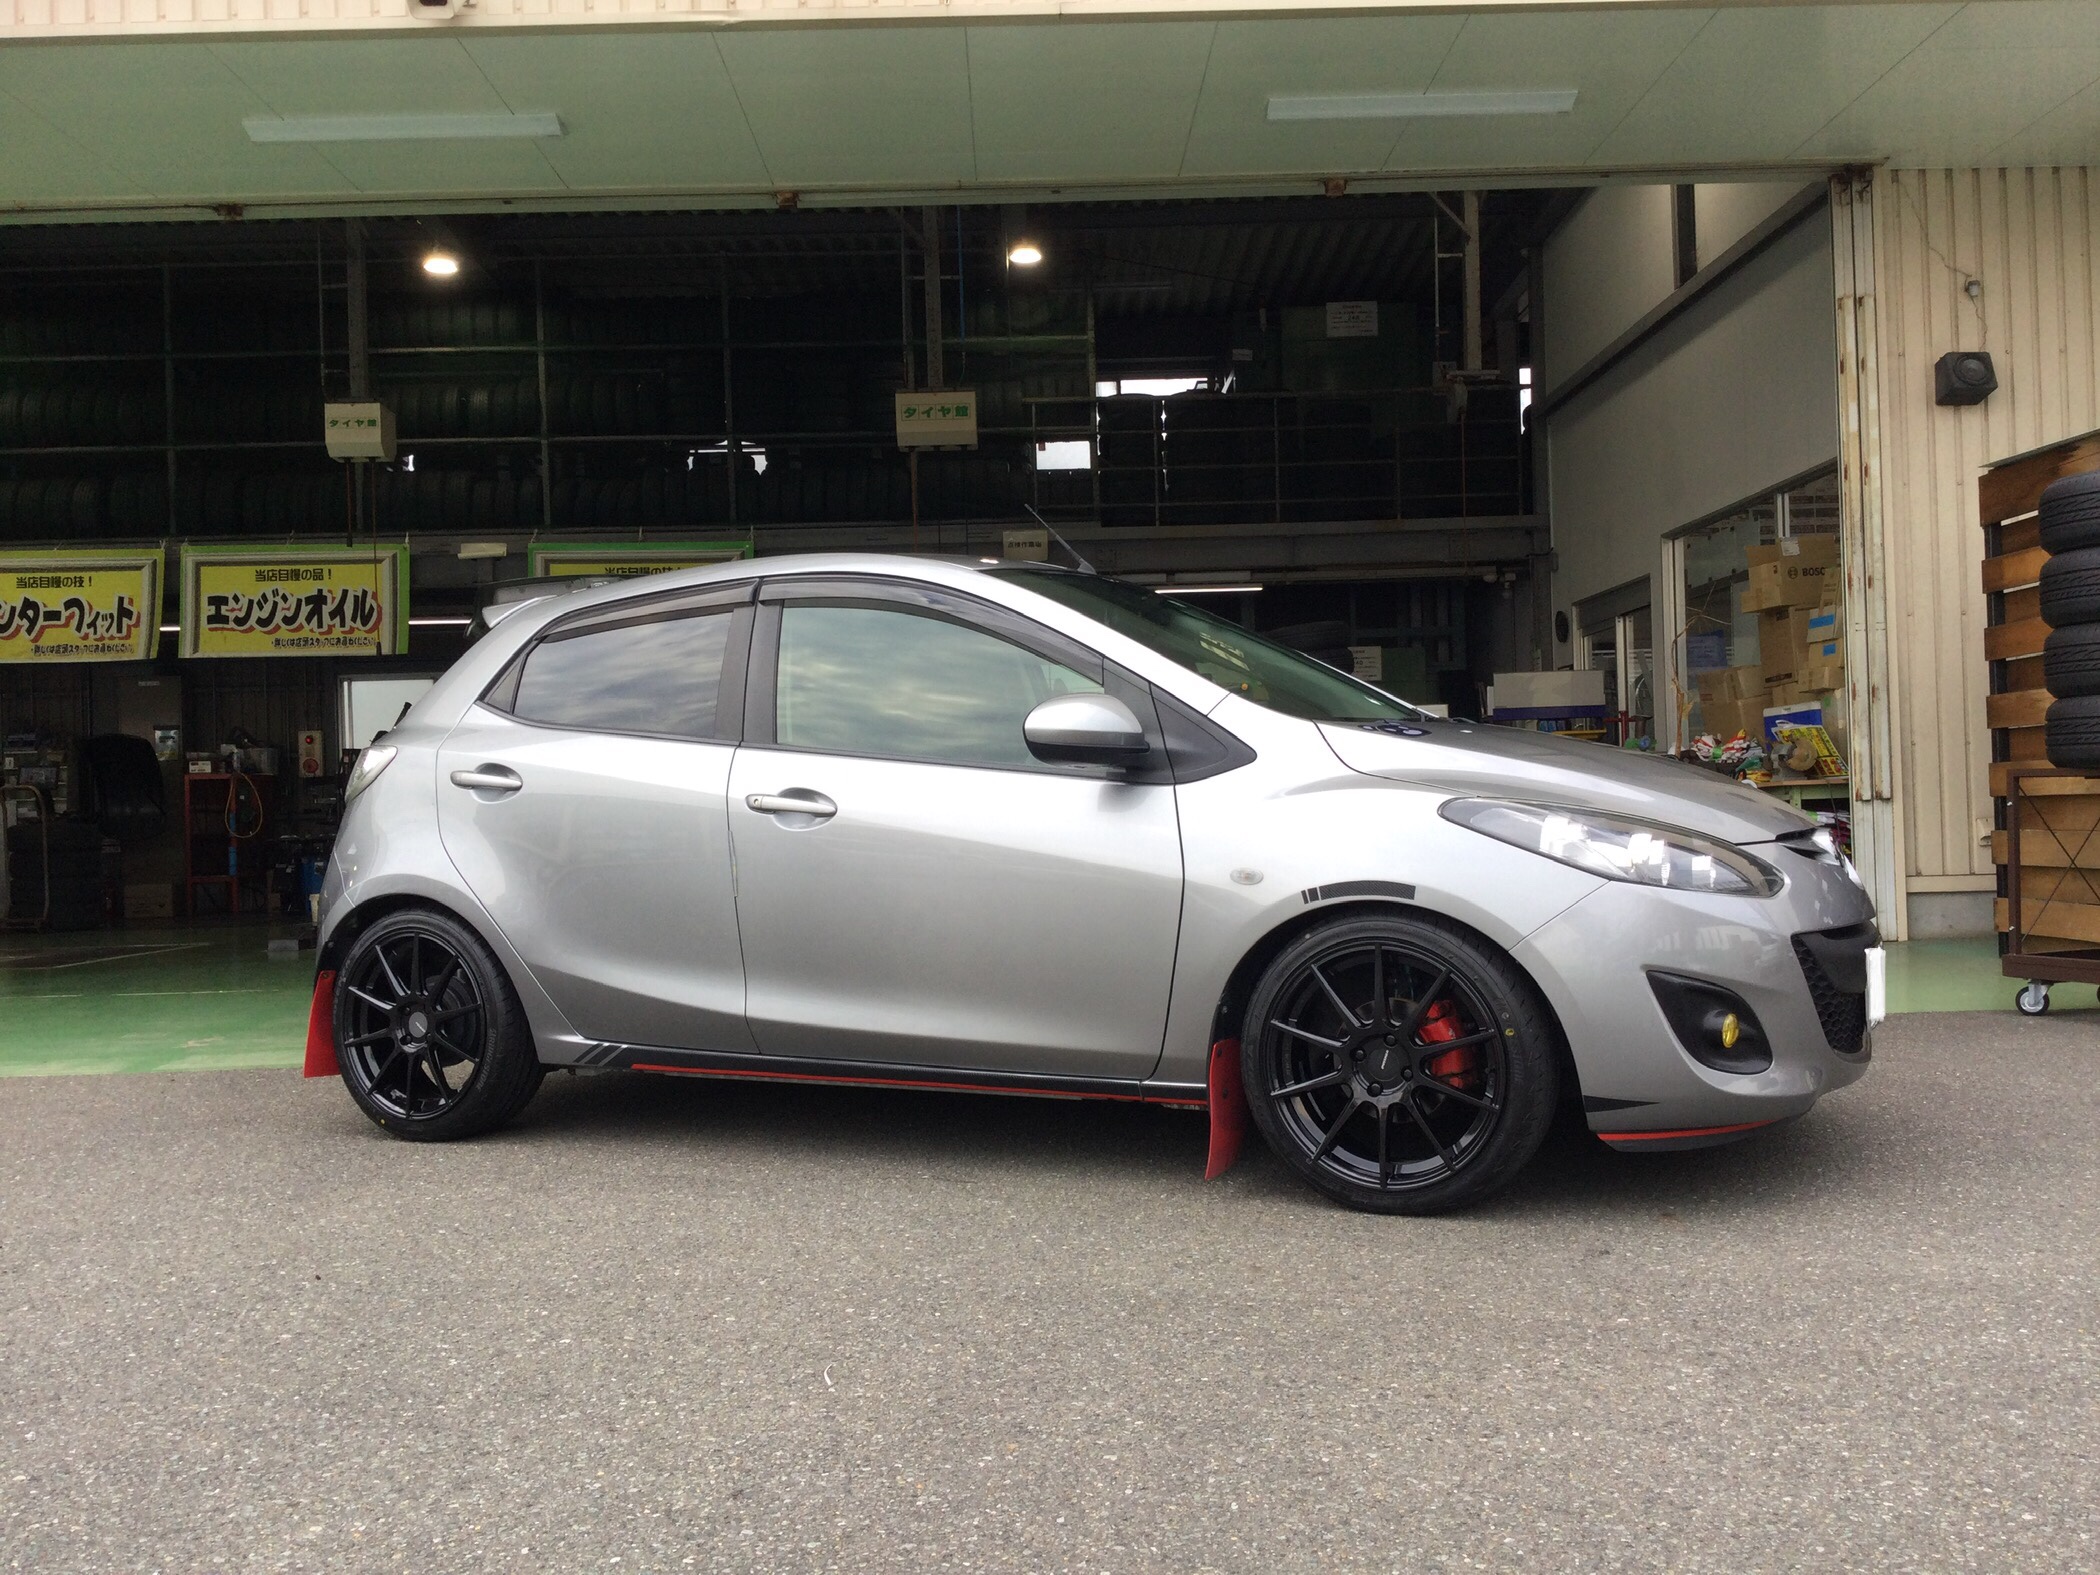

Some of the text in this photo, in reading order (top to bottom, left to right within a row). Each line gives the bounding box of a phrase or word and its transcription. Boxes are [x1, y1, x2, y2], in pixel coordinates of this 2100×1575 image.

[255, 568, 332, 581] 当店自慢の品！
[1802, 567, 1826, 577] BOSC
[16, 576, 93, 588] 当店自慢の技！
[206, 588, 376, 629] エンジンオイル
